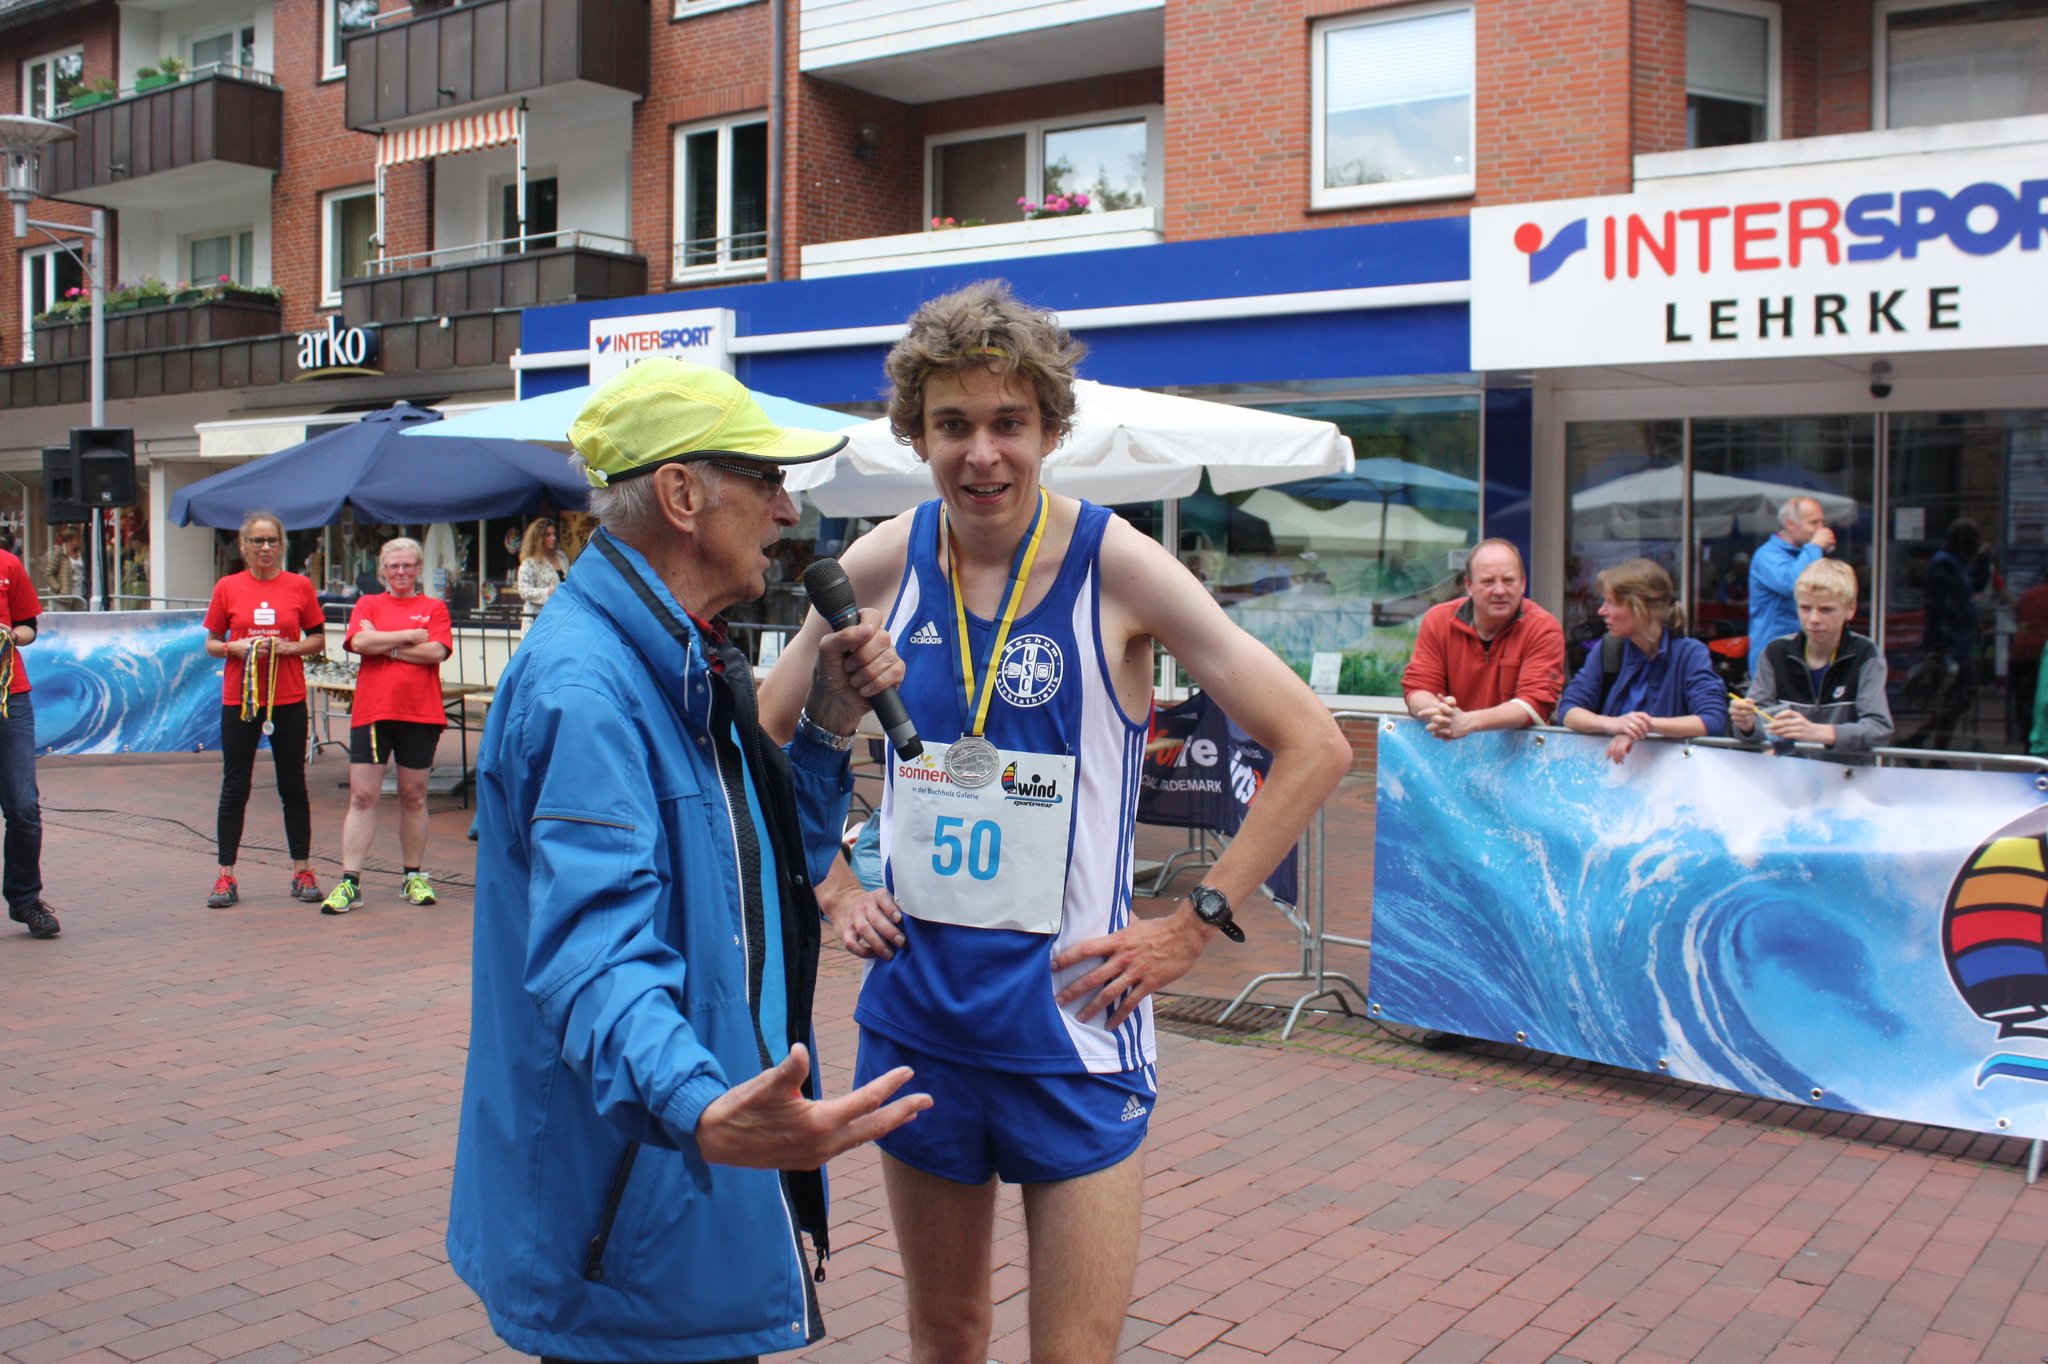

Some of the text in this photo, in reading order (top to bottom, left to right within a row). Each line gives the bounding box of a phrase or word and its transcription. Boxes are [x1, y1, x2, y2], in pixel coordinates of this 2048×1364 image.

[1665, 286, 1960, 343] LEHRKE
[297, 315, 366, 370] arko
[614, 326, 712, 352] INTERSPORT
[910, 635, 943, 644] adidas
[1005, 637, 1059, 657] Bochum
[1021, 649, 1036, 691] USC
[898, 765, 953, 784] sonnen
[927, 787, 955, 797] Buchholz
[956, 791, 979, 800] Galerie
[1018, 774, 1056, 798] wind
[1013, 800, 1053, 808] sportswear
[932, 815, 1001, 880] 50
[1121, 1106, 1147, 1121] adidas
